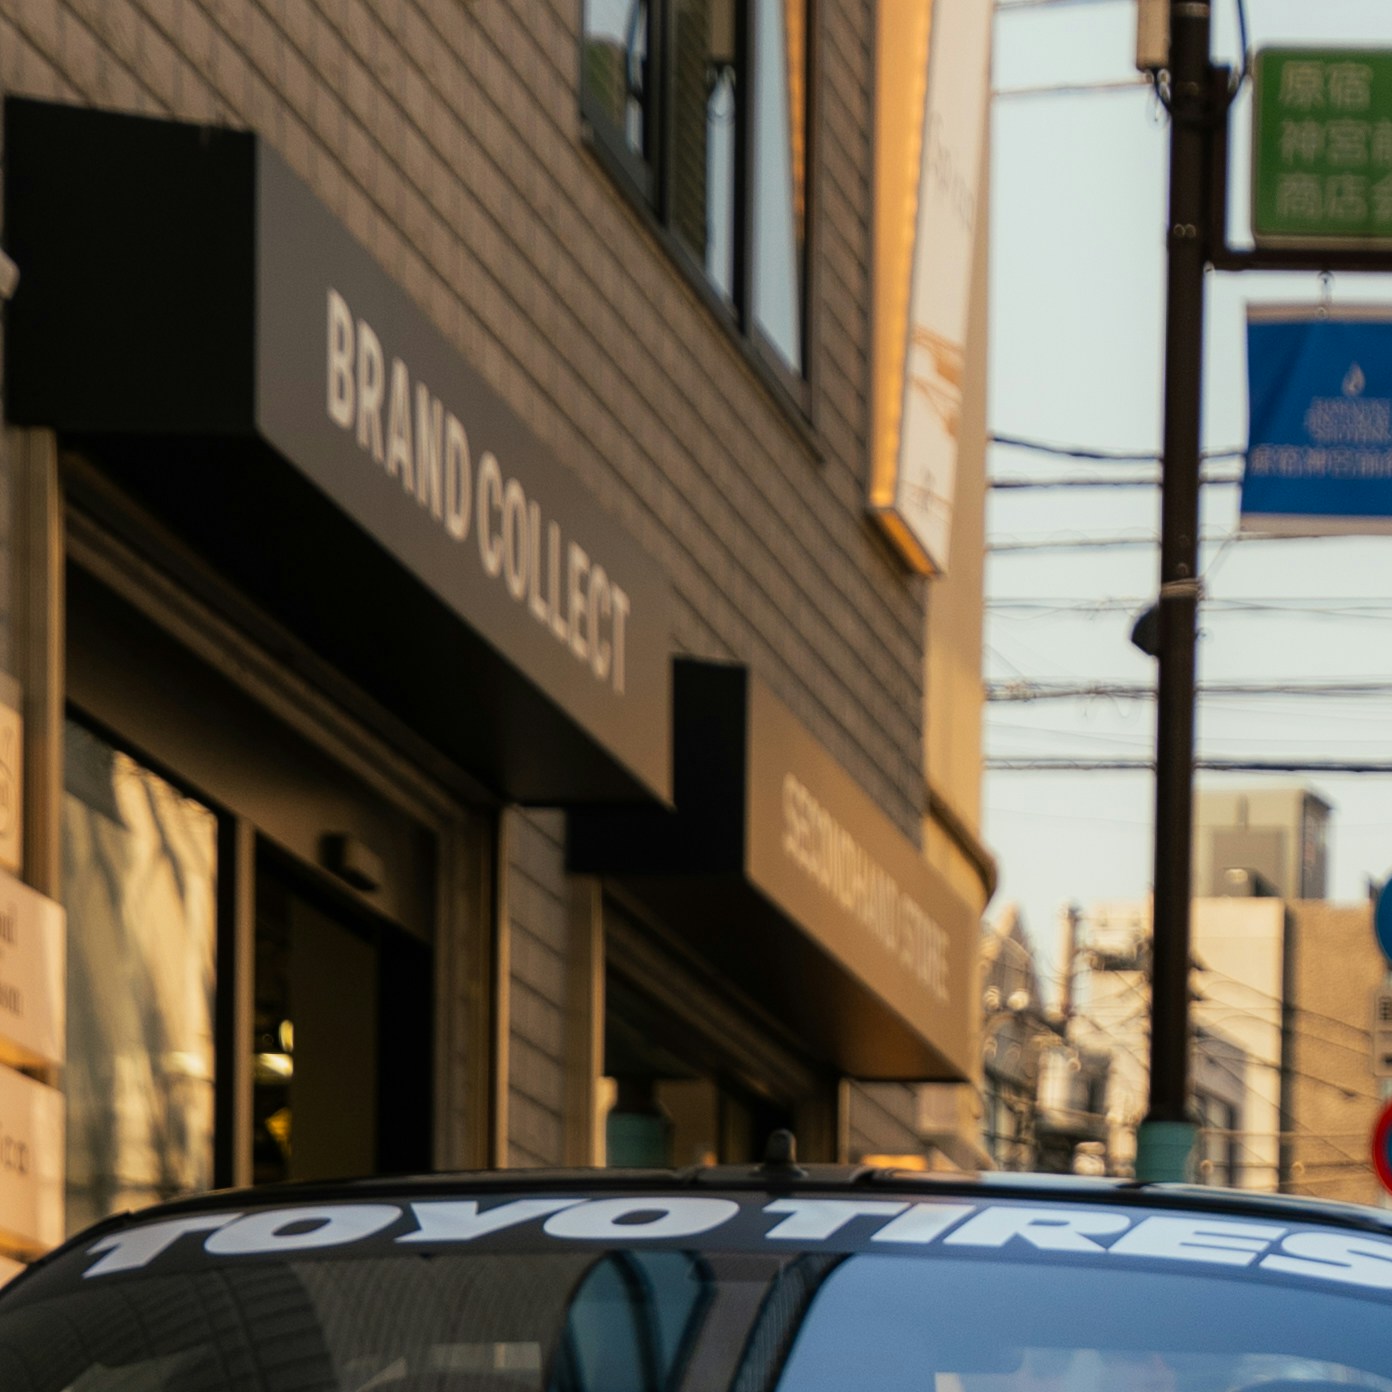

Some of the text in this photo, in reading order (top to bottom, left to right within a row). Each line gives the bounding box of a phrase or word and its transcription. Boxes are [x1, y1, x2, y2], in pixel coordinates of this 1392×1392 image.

[1279, 61, 1373, 111] 原宿
[327, 286, 631, 697] BRAND COLLECT
[83, 1198, 739, 1279] TOYO
